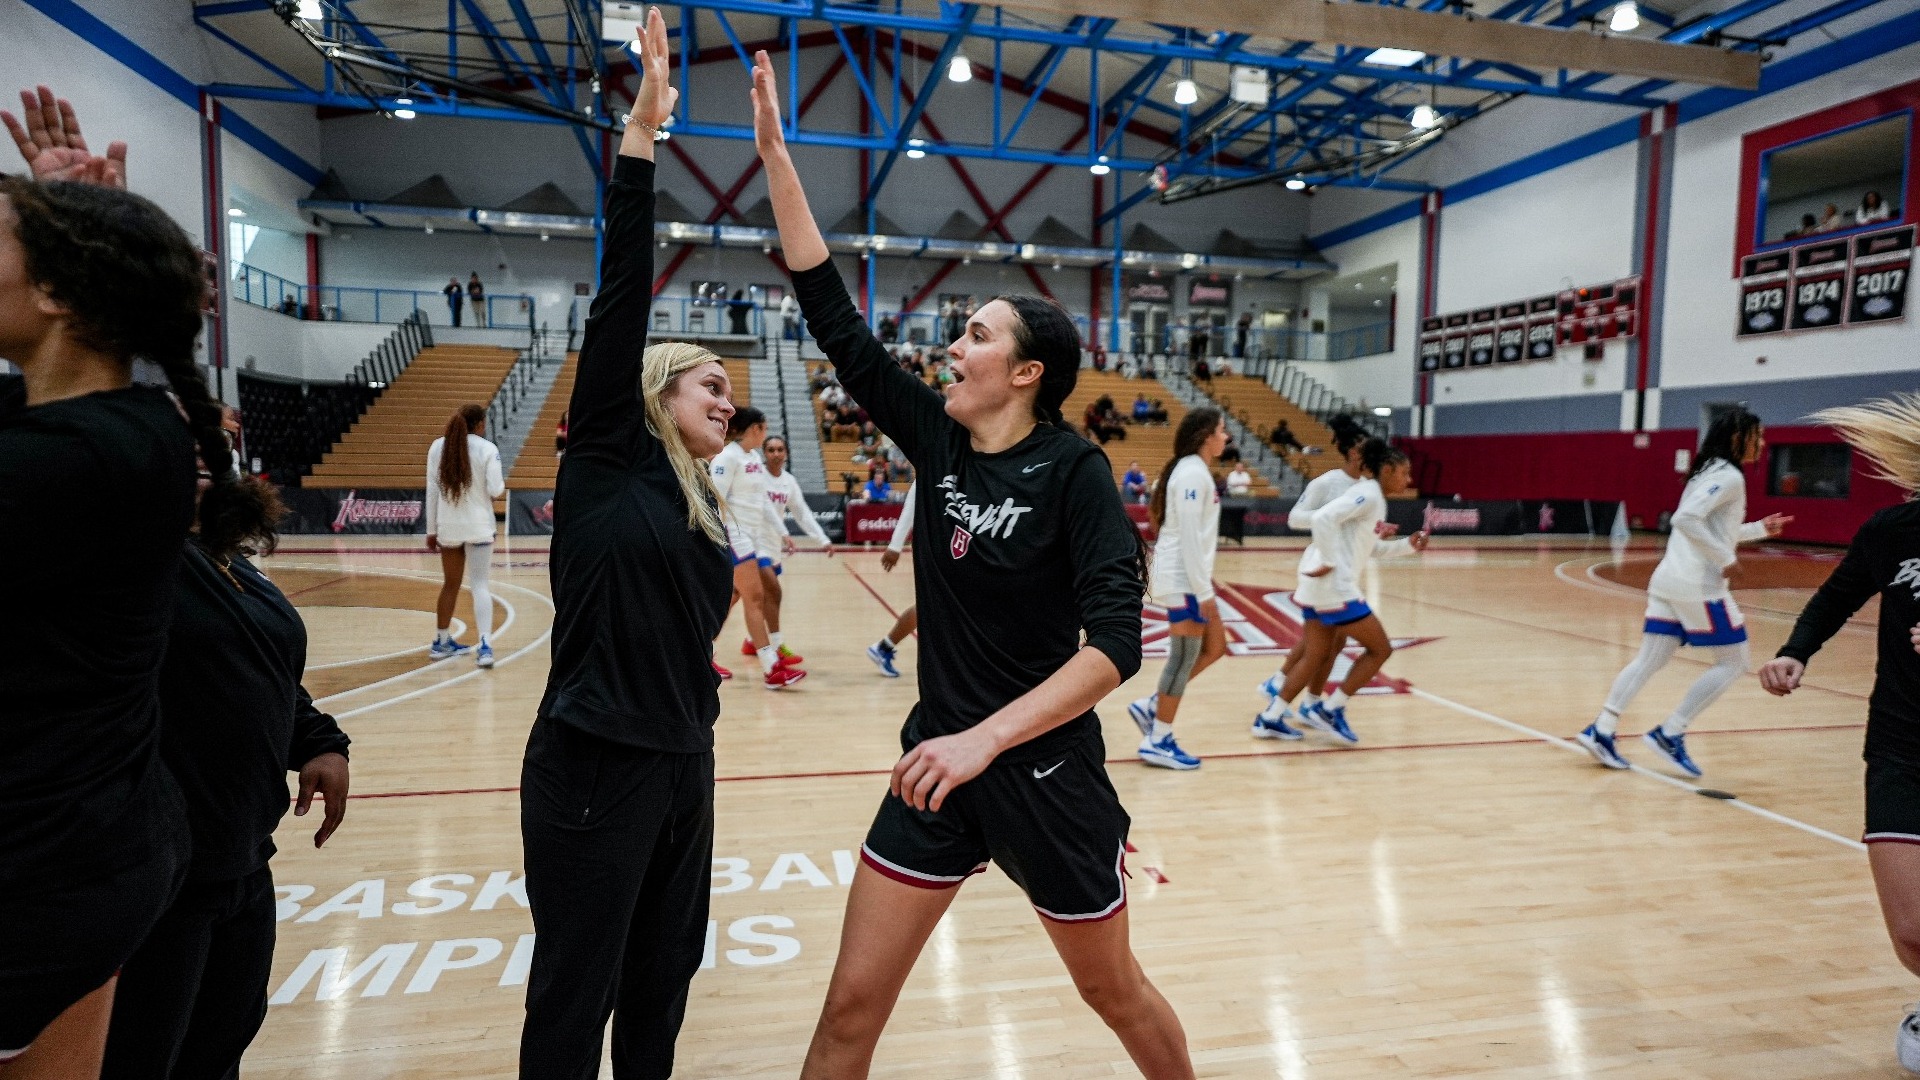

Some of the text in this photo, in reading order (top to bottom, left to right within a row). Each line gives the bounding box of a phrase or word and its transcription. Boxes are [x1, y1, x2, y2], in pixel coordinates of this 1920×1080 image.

[1798, 279, 1841, 306] 1974
[1856, 269, 1905, 297] 2017
[1744, 287, 1785, 312] 1973
[1184, 488, 1197, 501] 14
[335, 493, 421, 526] KNIGHTS
[857, 516, 899, 531] @sdcit
[953, 531, 967, 552] H
